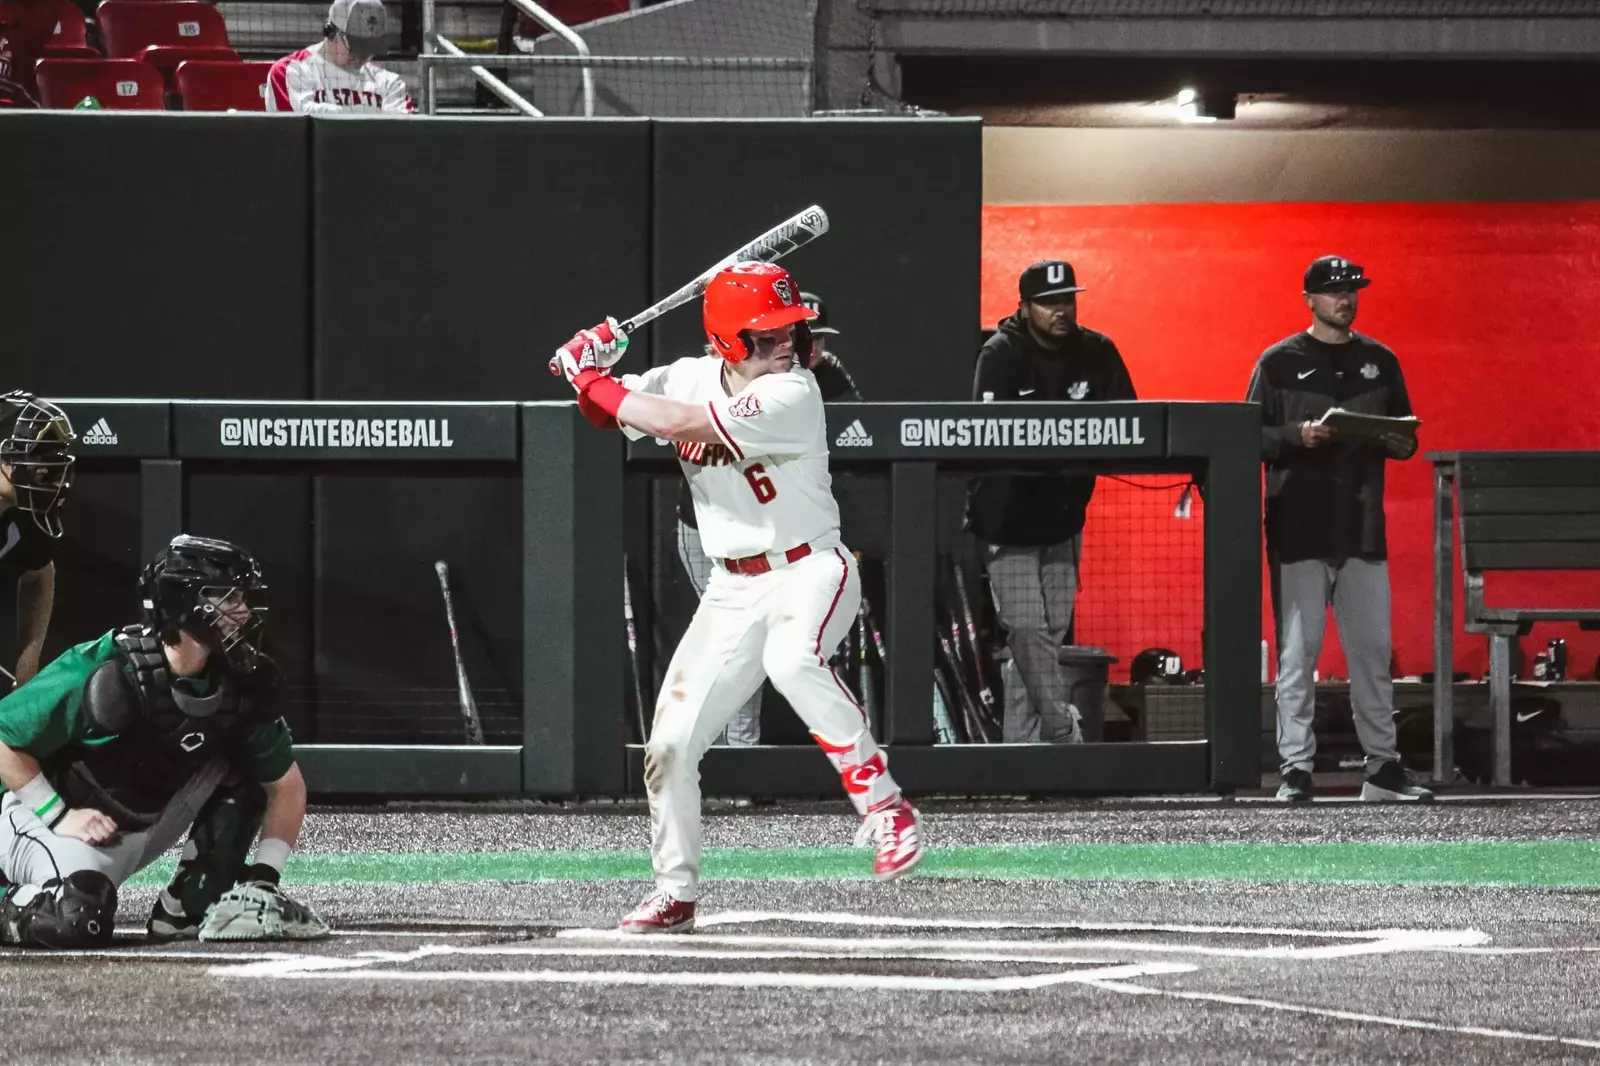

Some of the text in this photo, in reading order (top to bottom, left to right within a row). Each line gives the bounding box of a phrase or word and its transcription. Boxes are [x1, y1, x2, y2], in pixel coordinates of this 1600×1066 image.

[1047, 265, 1064, 283] U
[83, 433, 118, 445] adidas
[220, 418, 454, 447] @NCSTATEBASEBALL
[836, 435, 873, 447] adidas
[900, 417, 1146, 447] @NCSTATEBASEBALL
[744, 462, 777, 504] 6
